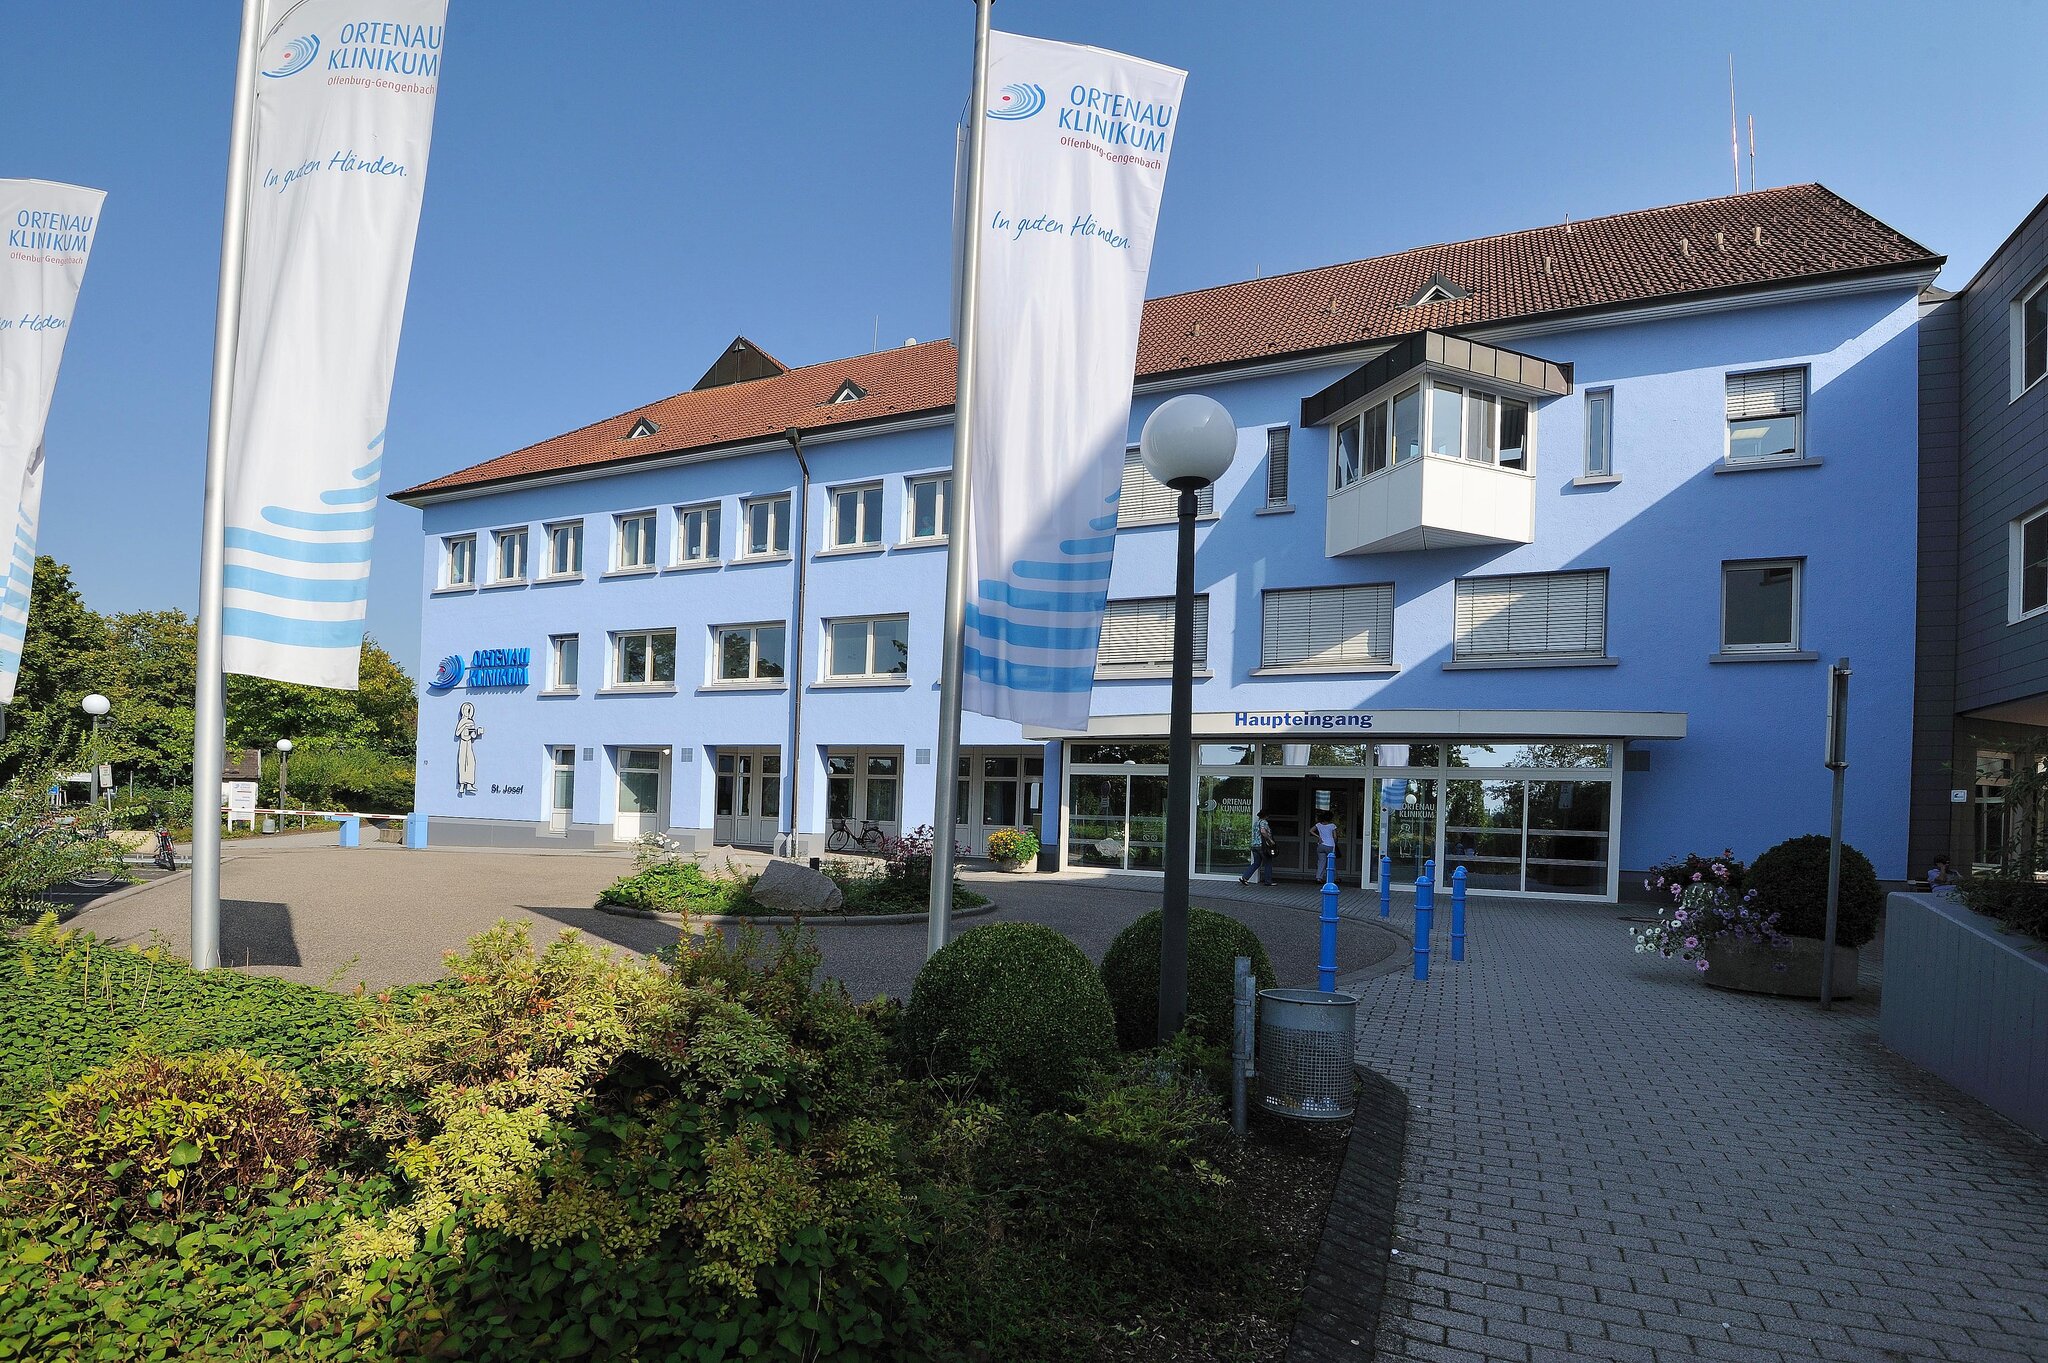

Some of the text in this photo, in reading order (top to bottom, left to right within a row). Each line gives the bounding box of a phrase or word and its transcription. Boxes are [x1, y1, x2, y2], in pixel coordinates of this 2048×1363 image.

[340, 22, 442, 50] ORTENAU
[327, 47, 438, 77] KLINIKUM
[327, 75, 435, 95] Offenburg-Gengenbach
[1070, 85, 1173, 128] ORTENAU
[1058, 107, 1166, 153] KLINIKUM
[1060, 136, 1162, 170] Offenburg-Gengenbach
[263, 149, 407, 194] In guten Händen.
[17, 209, 94, 233] ORTENAU
[991, 210, 1131, 249] In guten Händen.
[8, 229, 88, 252] KLINIKUM
[472, 647, 531, 667] ORTENAU
[467, 667, 529, 688] KLINIKUM
[1235, 711, 1374, 729] Haupteingang
[490, 783, 524, 795] St. Josef
[1222, 798, 1252, 806] ORTENAU
[1401, 803, 1435, 811] ORTENAU
[1399, 810, 1435, 819] KLINIKUM
